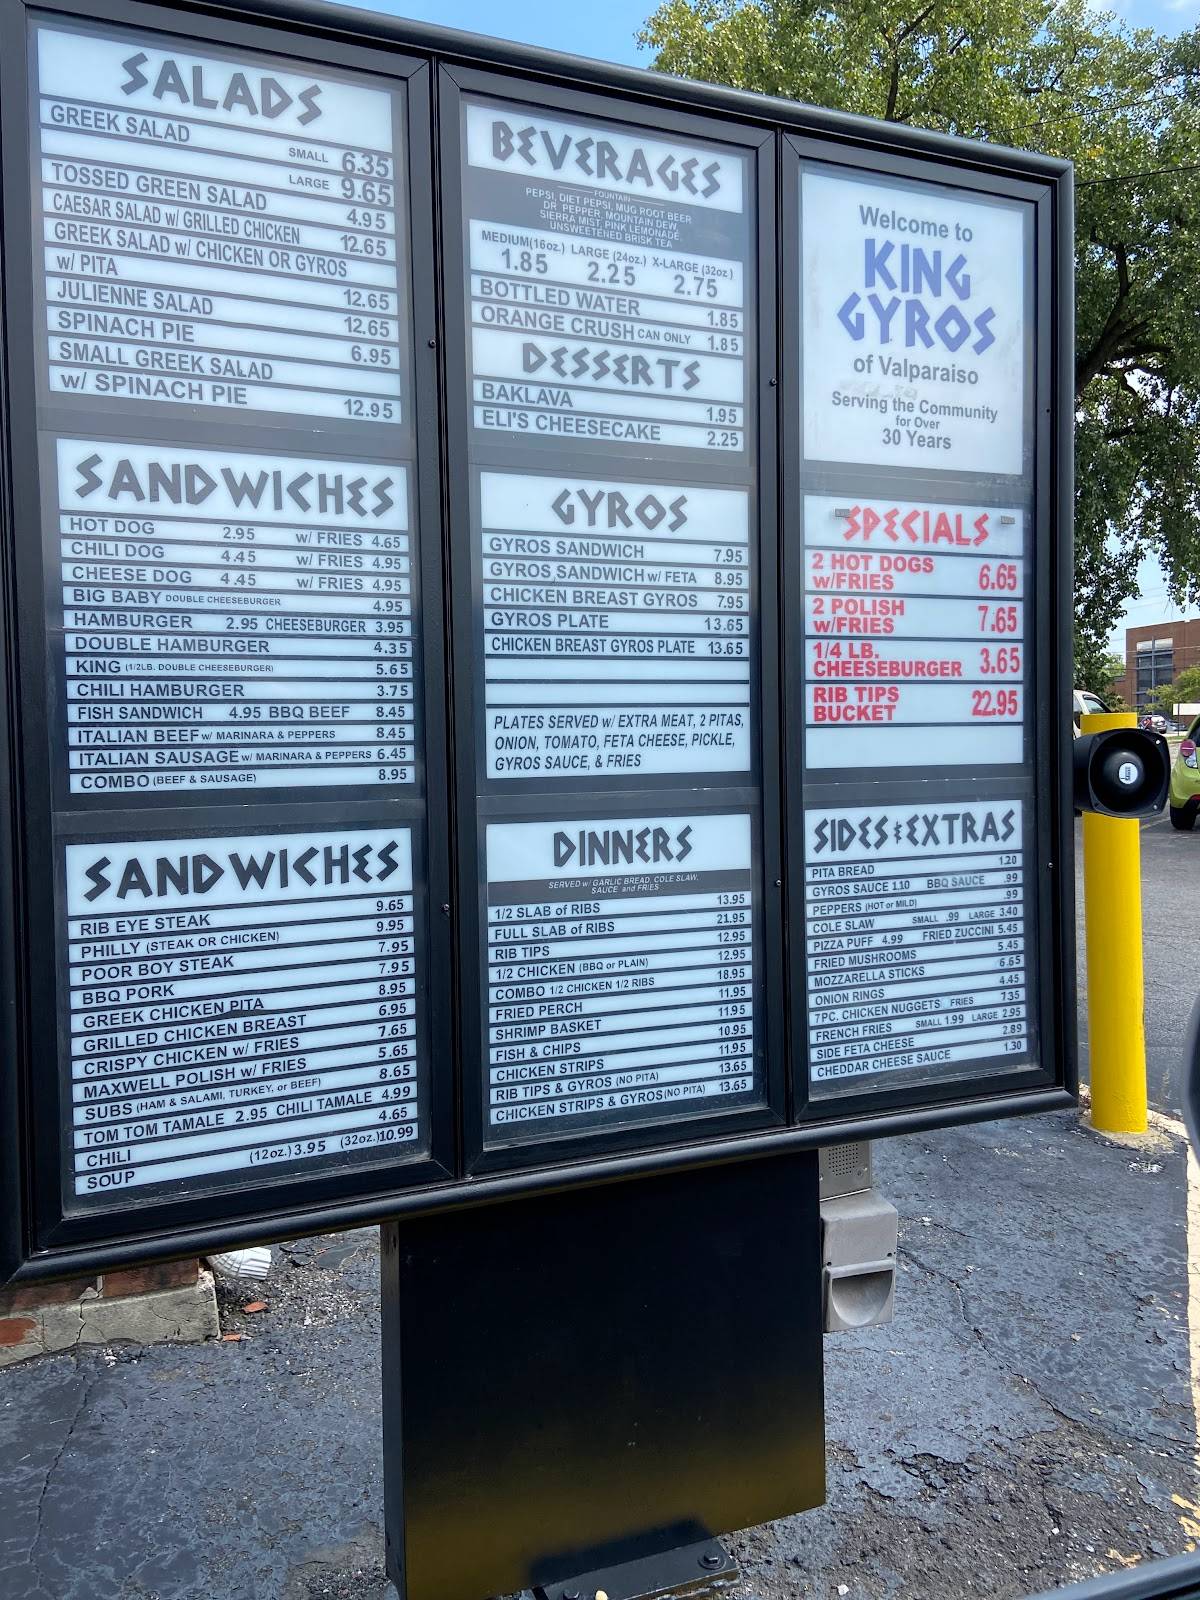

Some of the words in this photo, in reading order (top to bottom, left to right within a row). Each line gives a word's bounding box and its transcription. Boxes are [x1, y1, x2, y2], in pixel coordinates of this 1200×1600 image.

[120, 52, 322, 126] SALADS
[51, 105, 120, 132] GREEK
[126, 117, 190, 142] SALAD
[288, 147, 328, 163] SMALL
[342, 152, 390, 178] 6.35
[492, 121, 721, 198] BEVERAGES
[52, 162, 129, 189] TOSSED
[136, 176, 201, 200] GREEN
[207, 186, 267, 210] SALAD
[347, 209, 386, 229] 4.95
[289, 175, 329, 190] LARGE
[341, 178, 391, 206] 9.65
[594, 190, 631, 202] FOUNTAIN
[53, 193, 111, 218] CAESAR
[115, 201, 160, 225] SALAD
[165, 209, 179, 227] w/
[183, 210, 239, 235] GRILLED
[244, 220, 300, 244] CHICKEN
[340, 235, 386, 257] 12.65
[550, 222, 622, 240] UNSWEETENED
[625, 234, 652, 245] BRISK
[655, 239, 672, 248] TEA
[859, 205, 949, 238] Welcome
[955, 222, 973, 242] to
[865, 238, 971, 300] KING
[480, 280, 569, 305] BOTTLED
[576, 292, 639, 315] WATER
[707, 311, 738, 328] 1.85
[58, 310, 154, 338] SPINACH
[162, 323, 194, 343] PIE
[481, 306, 564, 331] ORANGE
[571, 318, 634, 340] CRUSH
[637, 328, 660, 340] CAN
[664, 333, 691, 345] ONLY
[708, 335, 738, 352] 1.85
[837, 292, 996, 355] GYROS
[522, 343, 700, 391] DESSERTS
[853, 355, 873, 372] of
[879, 356, 978, 384] Valparaiso
[482, 383, 573, 407] BAKLAVA
[706, 407, 737, 423] 1.95
[832, 391, 887, 413] Serving
[892, 398, 914, 412] the
[919, 400, 998, 423] Community
[483, 410, 528, 429] ELI'S
[535, 415, 661, 440] CHEESECAKE
[708, 432, 738, 446] 2.25
[896, 416, 911, 426] for
[915, 417, 940, 429] Over
[883, 428, 901, 445] 30
[907, 430, 951, 449] Years
[75, 453, 394, 517] SANDWICHES
[551, 488, 688, 532] GYROS
[70, 518, 108, 532] HOT
[114, 521, 155, 534] DOG
[223, 527, 255, 540] 2.95
[296, 532, 312, 544] w/
[317, 532, 362, 547] FRIES
[372, 535, 401, 549] 4.65
[843, 505, 989, 547] SPECIALS
[490, 537, 550, 553] GYROS
[556, 541, 644, 558] SANDWICH
[714, 549, 742, 563] 7.95
[812, 553, 823, 569] 2
[832, 554, 872, 571] HOT
[880, 556, 933, 572] DOGS
[813, 574, 894, 589] w/FRIES
[979, 564, 1017, 590] 6.65
[73, 589, 105, 602] BIG
[112, 590, 161, 604] BABY
[207, 597, 281, 606] CHEESEBURGER
[373, 600, 402, 613] 4.95
[491, 587, 567, 603] CHICKEN
[573, 590, 638, 605] BREAST
[643, 593, 697, 607] GYROS
[717, 595, 743, 609] 7.95
[813, 598, 824, 614] 2
[831, 599, 905, 615] POLISH
[492, 612, 551, 627] GYROS
[558, 613, 609, 628] PLATE
[704, 617, 743, 631] 13.65
[978, 606, 1016, 632] 7.65
[814, 643, 841, 658] 1/4
[848, 643, 879, 658] LB.
[980, 648, 1019, 674] 3.65
[814, 661, 962, 676] CHEESEBURGER
[77, 683, 124, 696] CHILI
[130, 684, 244, 697] HAMBURGER
[377, 685, 408, 697] 3.75
[814, 687, 847, 702] RIB
[854, 687, 899, 702] TIPS
[972, 691, 1017, 716] 22.95
[494, 715, 544, 730] PLATES
[548, 715, 598, 729] SERVED
[602, 716, 616, 728] w/
[619, 714, 657, 728] EXTRA
[661, 714, 696, 729] MEAT,
[700, 715, 706, 726] 2
[709, 714, 744, 728] PITAS,
[814, 705, 896, 721] BUCKET
[79, 752, 149, 766] ITALIAN
[155, 751, 239, 764] SAUSAGE
[256, 752, 312, 761] MARINARA
[315, 751, 322, 759] &
[325, 751, 372, 760] PEPPERS
[377, 748, 406, 760] 6.45
[553, 825, 693, 867] DINNERS
[813, 815, 888, 853] SIDES
[906, 809, 1014, 846] EXTRAS
[83, 840, 399, 902] SANDWICHES
[812, 868, 834, 878] PITA
[838, 865, 874, 876] BREAD
[999, 856, 1016, 865] 1.20
[591, 885, 618, 894] SAUCE
[622, 885, 635, 893] and
[637, 884, 658, 892] FRIES
[81, 922, 109, 936] RIB
[116, 919, 149, 933] EYE
[155, 913, 210, 931] STEAK
[377, 900, 404, 912] 9.65
[496, 908, 512, 919] 1/2
[516, 906, 551, 918] SLAB
[555, 905, 567, 916] of
[571, 903, 600, 915] RIBS
[717, 894, 745, 905] 13.95
[81, 942, 140, 958] PHILLY
[146, 936, 193, 955] (STEAK
[198, 937, 215, 947] OR
[220, 931, 280, 944] CHICKEN)
[377, 920, 404, 932] 9.95
[814, 957, 845, 969] FRIED
[849, 951, 916, 966] MUSHROOMS
[998, 940, 1018, 950] 5.45
[496, 1005, 534, 1020] FRIED
[539, 1002, 582, 1015] PERCH
[719, 987, 746, 998] 11.95
[816, 1029, 859, 1041] FRENCH
[862, 1023, 892, 1034] FRIES
[916, 1019, 942, 1028] SMALL
[945, 1015, 964, 1025] 1.99
[972, 1012, 998, 1021] LARGE
[1002, 1008, 1020, 1018] 2.95
[496, 1047, 525, 1061] FISH
[531, 1047, 538, 1057] &
[542, 1043, 580, 1056] CHIPS
[719, 1024, 746, 1035] 10.95
[84, 1077, 169, 1098] MAXWELL
[176, 1068, 235, 1086] POLISH
[241, 1065, 257, 1077] w/
[262, 1058, 307, 1075] FRIES
[378, 1045, 407, 1059] 5.65
[817, 1062, 868, 1077] CHEDDAR
[872, 1056, 913, 1069] CHEESE
[917, 1050, 950, 1064] SAUCE
[1004, 1041, 1022, 1051] 1.30
[87, 1151, 131, 1167] CHILI
[379, 1107, 407, 1121] 4.65
